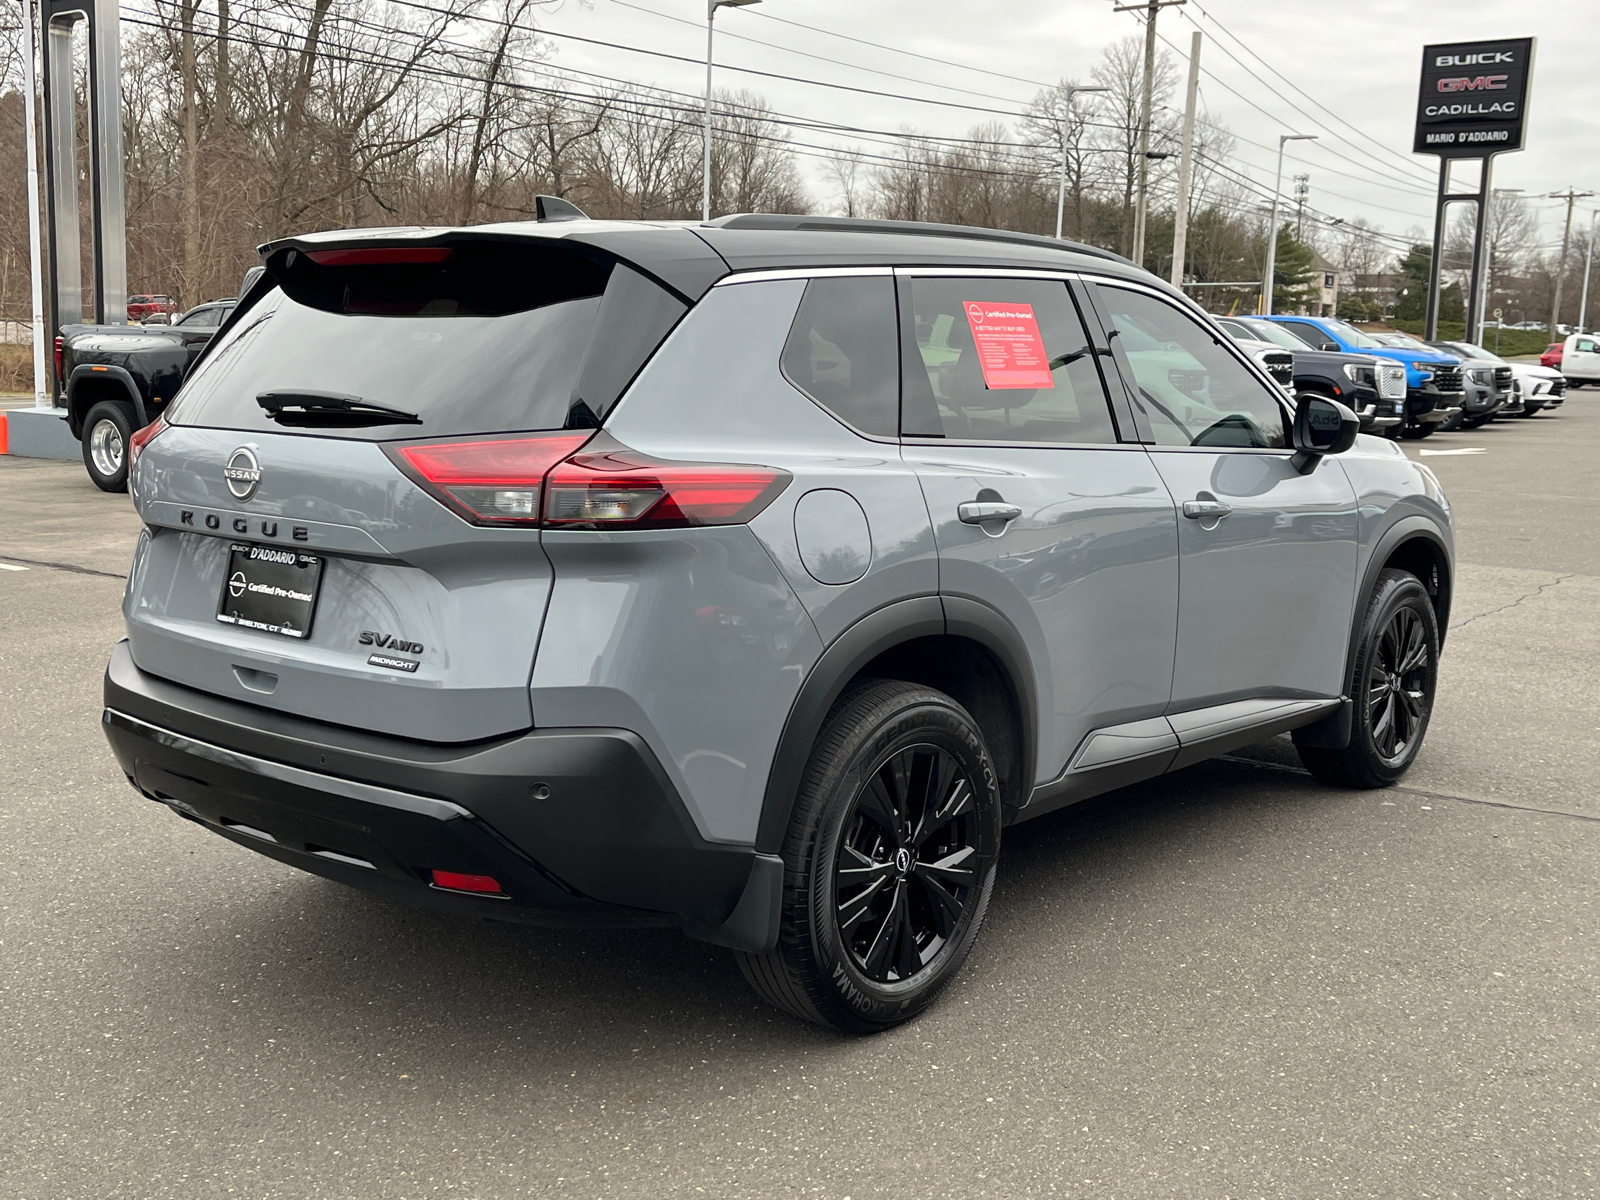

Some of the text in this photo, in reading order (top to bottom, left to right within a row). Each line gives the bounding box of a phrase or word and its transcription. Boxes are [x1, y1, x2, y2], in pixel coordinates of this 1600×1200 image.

[1435, 51, 1514, 67] BUICK
[1437, 74, 1509, 92] GMC
[1425, 101, 1516, 116] CADILLAC
[1426, 130, 1509, 144] MARIO D'ADDARIO
[224, 469, 260, 480] NISSAN
[181, 509, 308, 541] ROGUE
[231, 544, 318, 565] BUICK D'ADDARIO GMC
[248, 582, 313, 602] Certified Pre-Owned
[269, 624, 279, 633] CT
[358, 630, 424, 654] SV AWD
[370, 656, 415, 669] MIDNIGHT
[832, 961, 889, 1018] OKOHAMA
